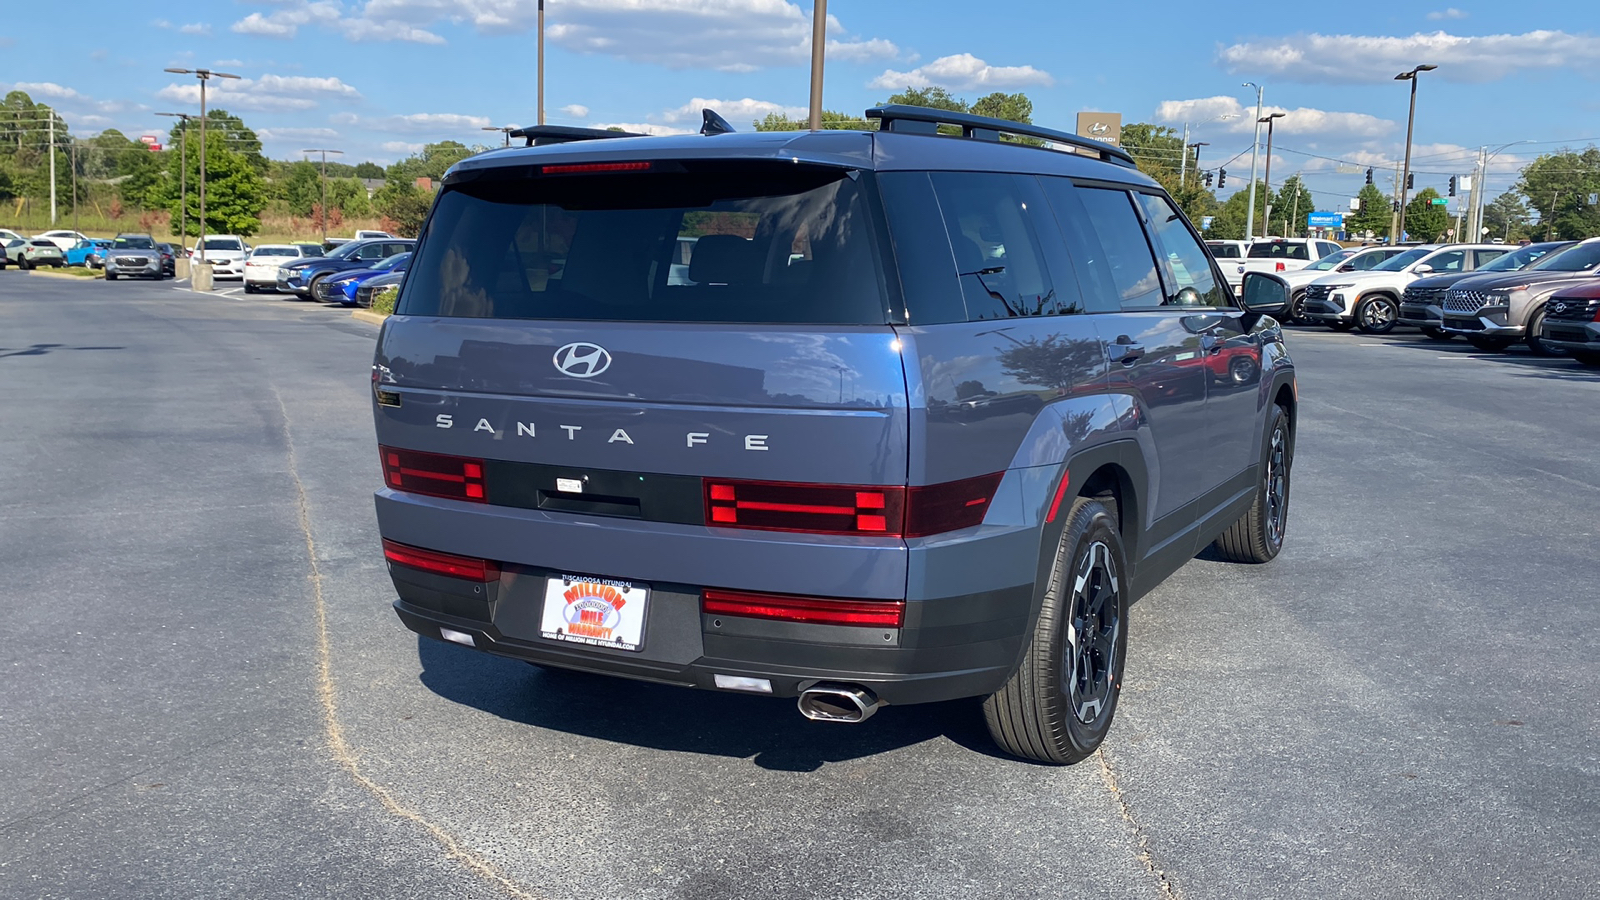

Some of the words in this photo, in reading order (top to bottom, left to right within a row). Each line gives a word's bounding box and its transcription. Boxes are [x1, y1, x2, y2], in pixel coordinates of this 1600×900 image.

[436, 413, 634, 445] SANTA
[686, 432, 769, 451] FE
[562, 574, 601, 584] TUSCALOOSA
[602, 579, 632, 588] HYUNDAI
[563, 583, 626, 611] MILLION
[580, 609, 605, 626] MILE
[542, 631, 557, 640] HOME
[565, 635, 586, 644] MILLION
[586, 638, 598, 646] MILE
[568, 622, 613, 639] WARRANTY
